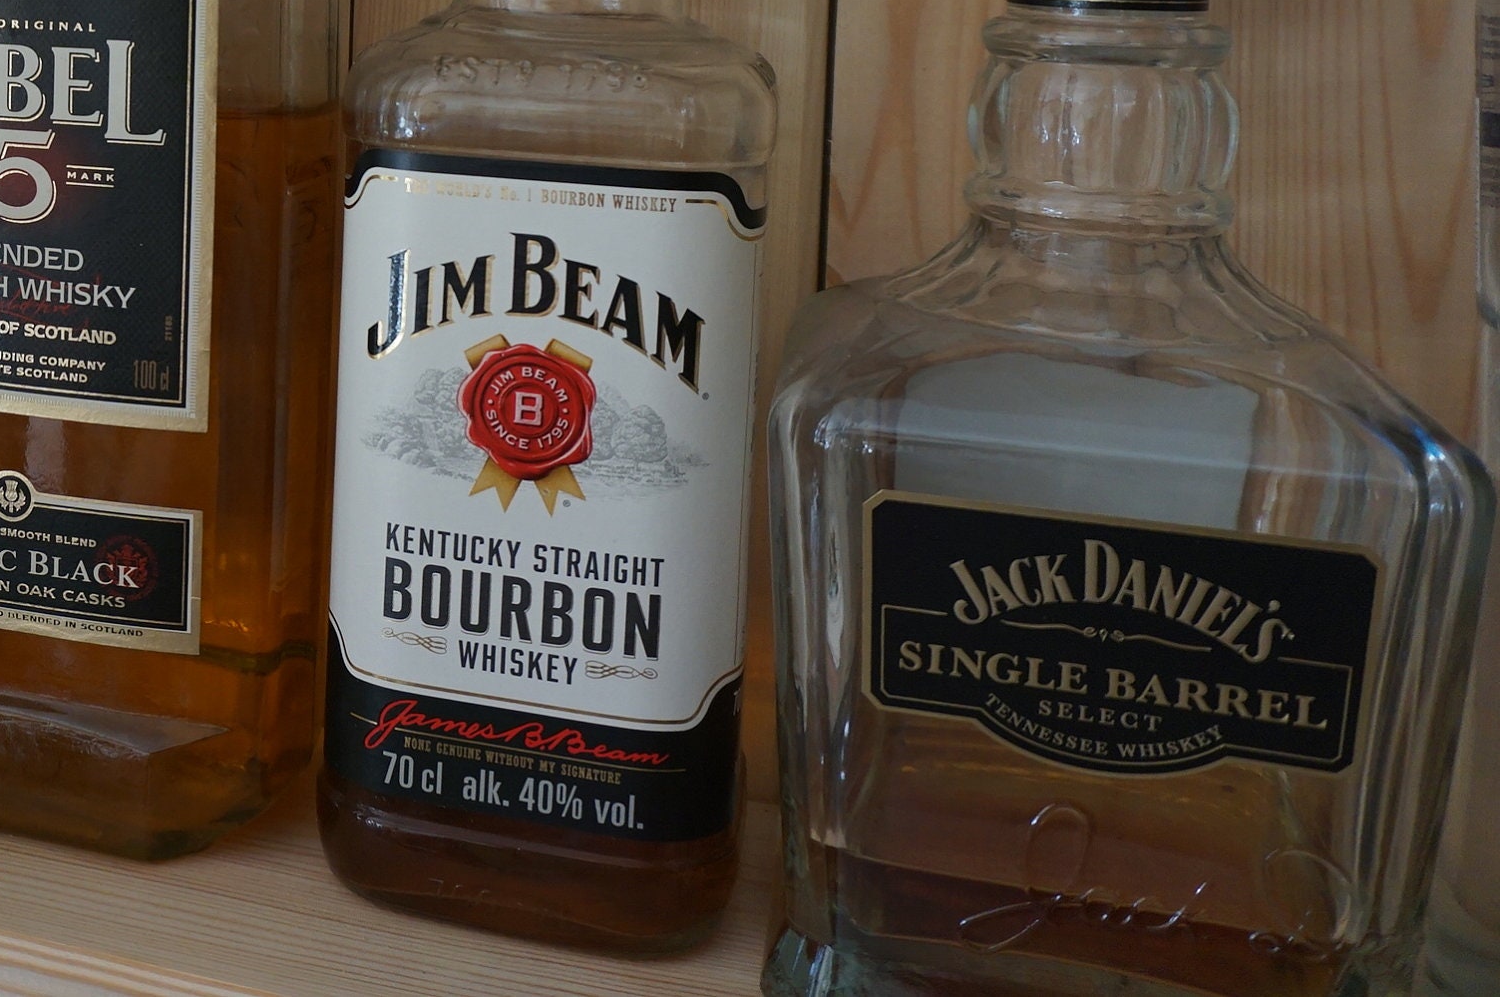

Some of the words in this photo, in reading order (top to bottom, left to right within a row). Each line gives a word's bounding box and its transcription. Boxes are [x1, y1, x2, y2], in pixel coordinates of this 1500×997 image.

[66, 170, 115, 183] MARK
[541, 189, 605, 208] BOURBON
[613, 195, 678, 213] WHISKEY
[18, 278, 137, 309] WHISKY
[367, 248, 495, 360] JIM
[504, 231, 706, 396] BEAM
[24, 322, 117, 345] SCOTLAND
[16, 367, 88, 384] SCOTLAND
[39, 356, 106, 372] COMPANY
[133, 359, 157, 390] 100
[160, 365, 171, 391] cl
[489, 368, 514, 396] JIM
[521, 366, 569, 404] BEAM
[513, 390, 543, 427] B
[485, 409, 530, 451] SINCE
[539, 418, 569, 450] 1795
[0, 527, 51, 542] SMOOTH
[55, 534, 97, 548] BLEND
[386, 522, 521, 569] KENTUCKY
[533, 544, 665, 588] STRAIGHT
[28, 550, 140, 589] BLACK
[16, 582, 57, 600] OAK
[63, 588, 126, 609] CASKS
[383, 557, 661, 661] BOURBON
[949, 553, 1078, 625] JACK
[1083, 538, 1296, 665] DANIEL'S
[7, 611, 61, 628] BLENDED
[64, 619, 77, 630] IN
[80, 622, 144, 638] SCOTLAND
[458, 640, 579, 685] WHISKEY
[899, 642, 1088, 694] SINGLE
[1105, 667, 1328, 730] BARREL
[364, 699, 497, 749] James
[548, 729, 669, 766] Beam
[985, 692, 1109, 757] TENNESSEE
[1117, 723, 1225, 759] WHISKEY
[1039, 700, 1163, 733] SELECT
[404, 736, 431, 753] NONE
[436, 742, 482, 761] GENUINE
[485, 750, 534, 770] WITHOUT
[539, 759, 555, 773] MY
[561, 763, 622, 785] SIGNATURE
[382, 750, 413, 789] 70
[421, 761, 443, 795] cl
[462, 771, 510, 808] alk.
[518, 777, 583, 820] 40%
[594, 795, 644, 830] vol.
